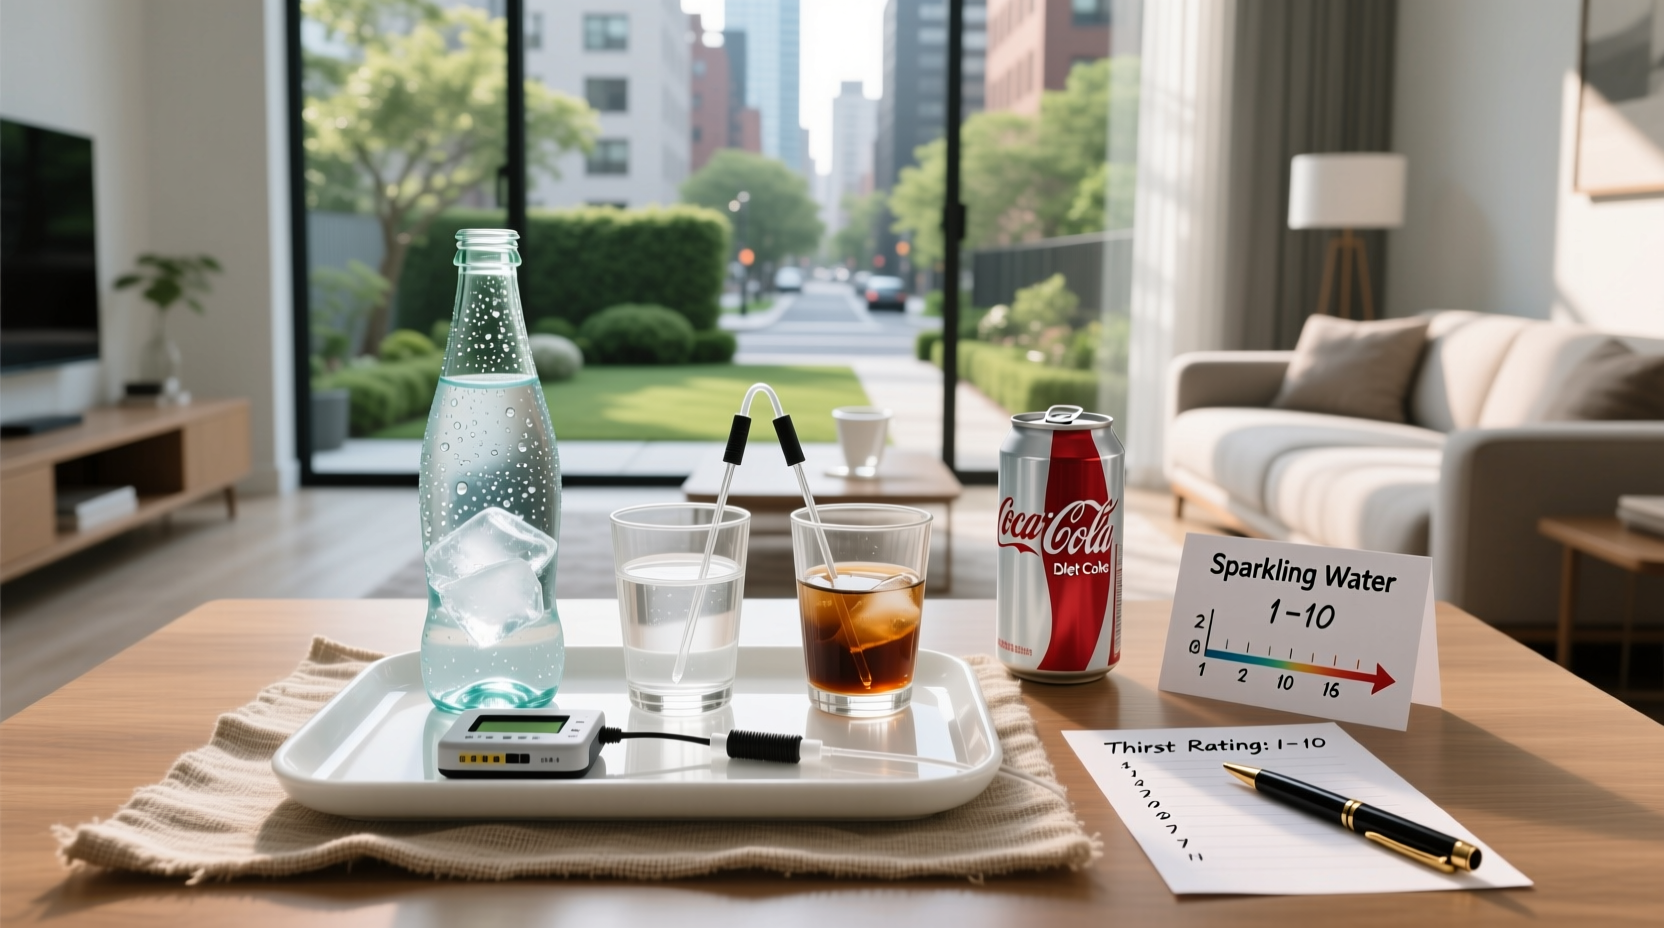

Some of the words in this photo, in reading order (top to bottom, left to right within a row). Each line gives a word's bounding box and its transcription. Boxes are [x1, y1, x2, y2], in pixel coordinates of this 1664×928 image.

[1209, 552, 1318, 592] Sparkling
[1325, 564, 1398, 593] Water
[1193, 613, 1206, 630] 2
[1198, 661, 1207, 677] 1
[1237, 667, 1249, 683] 2
[1276, 673, 1295, 691] 10
[1322, 681, 1341, 699] 16
[1103, 740, 1176, 755] Thirst
[1188, 738, 1269, 756] Rating:
